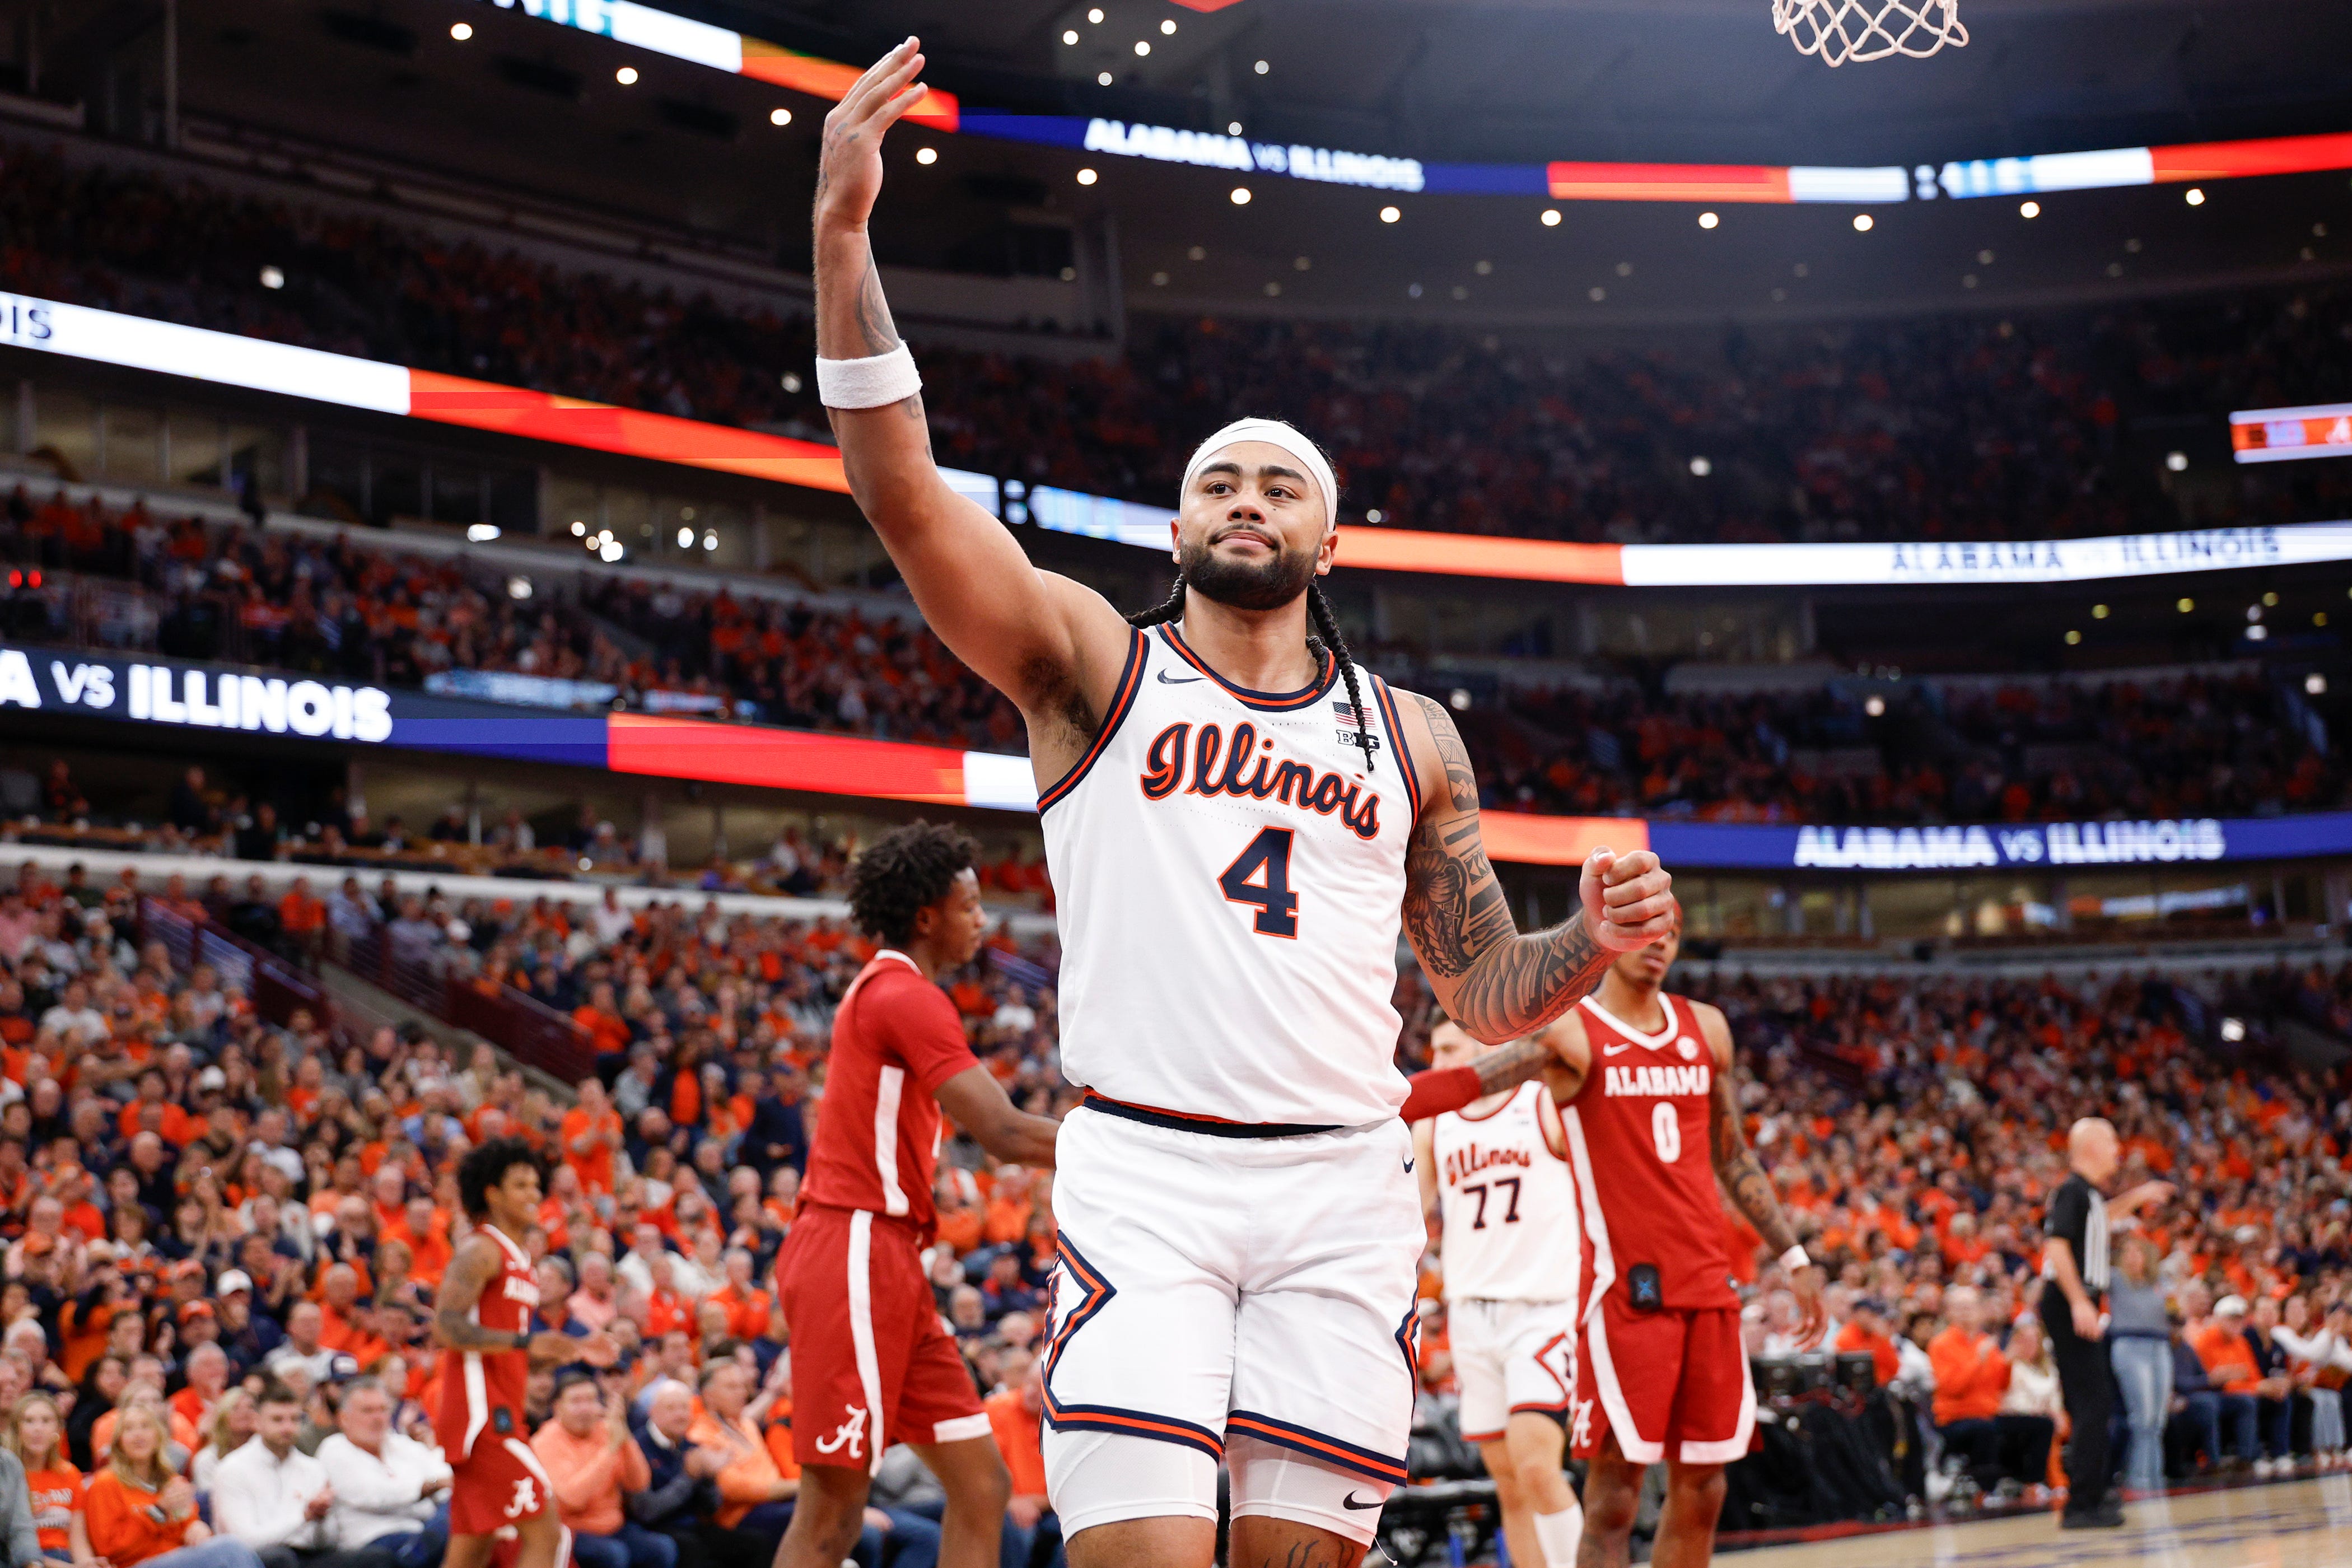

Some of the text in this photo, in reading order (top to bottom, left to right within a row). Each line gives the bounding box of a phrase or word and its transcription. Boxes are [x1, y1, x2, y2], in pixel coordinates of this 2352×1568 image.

[1084, 117, 1255, 172] ALABAMA
[1289, 144, 1425, 192] ILLINOIS
[128, 664, 393, 743] ILLINOIS
[1141, 721, 1380, 840] Illinois
[1794, 825, 1999, 868] ALABAMA
[2046, 819, 2225, 864] ILLINOIS
[1217, 825, 1299, 939] 4
[1651, 1102, 1682, 1164] 0
[1462, 1177, 1520, 1230] 77
